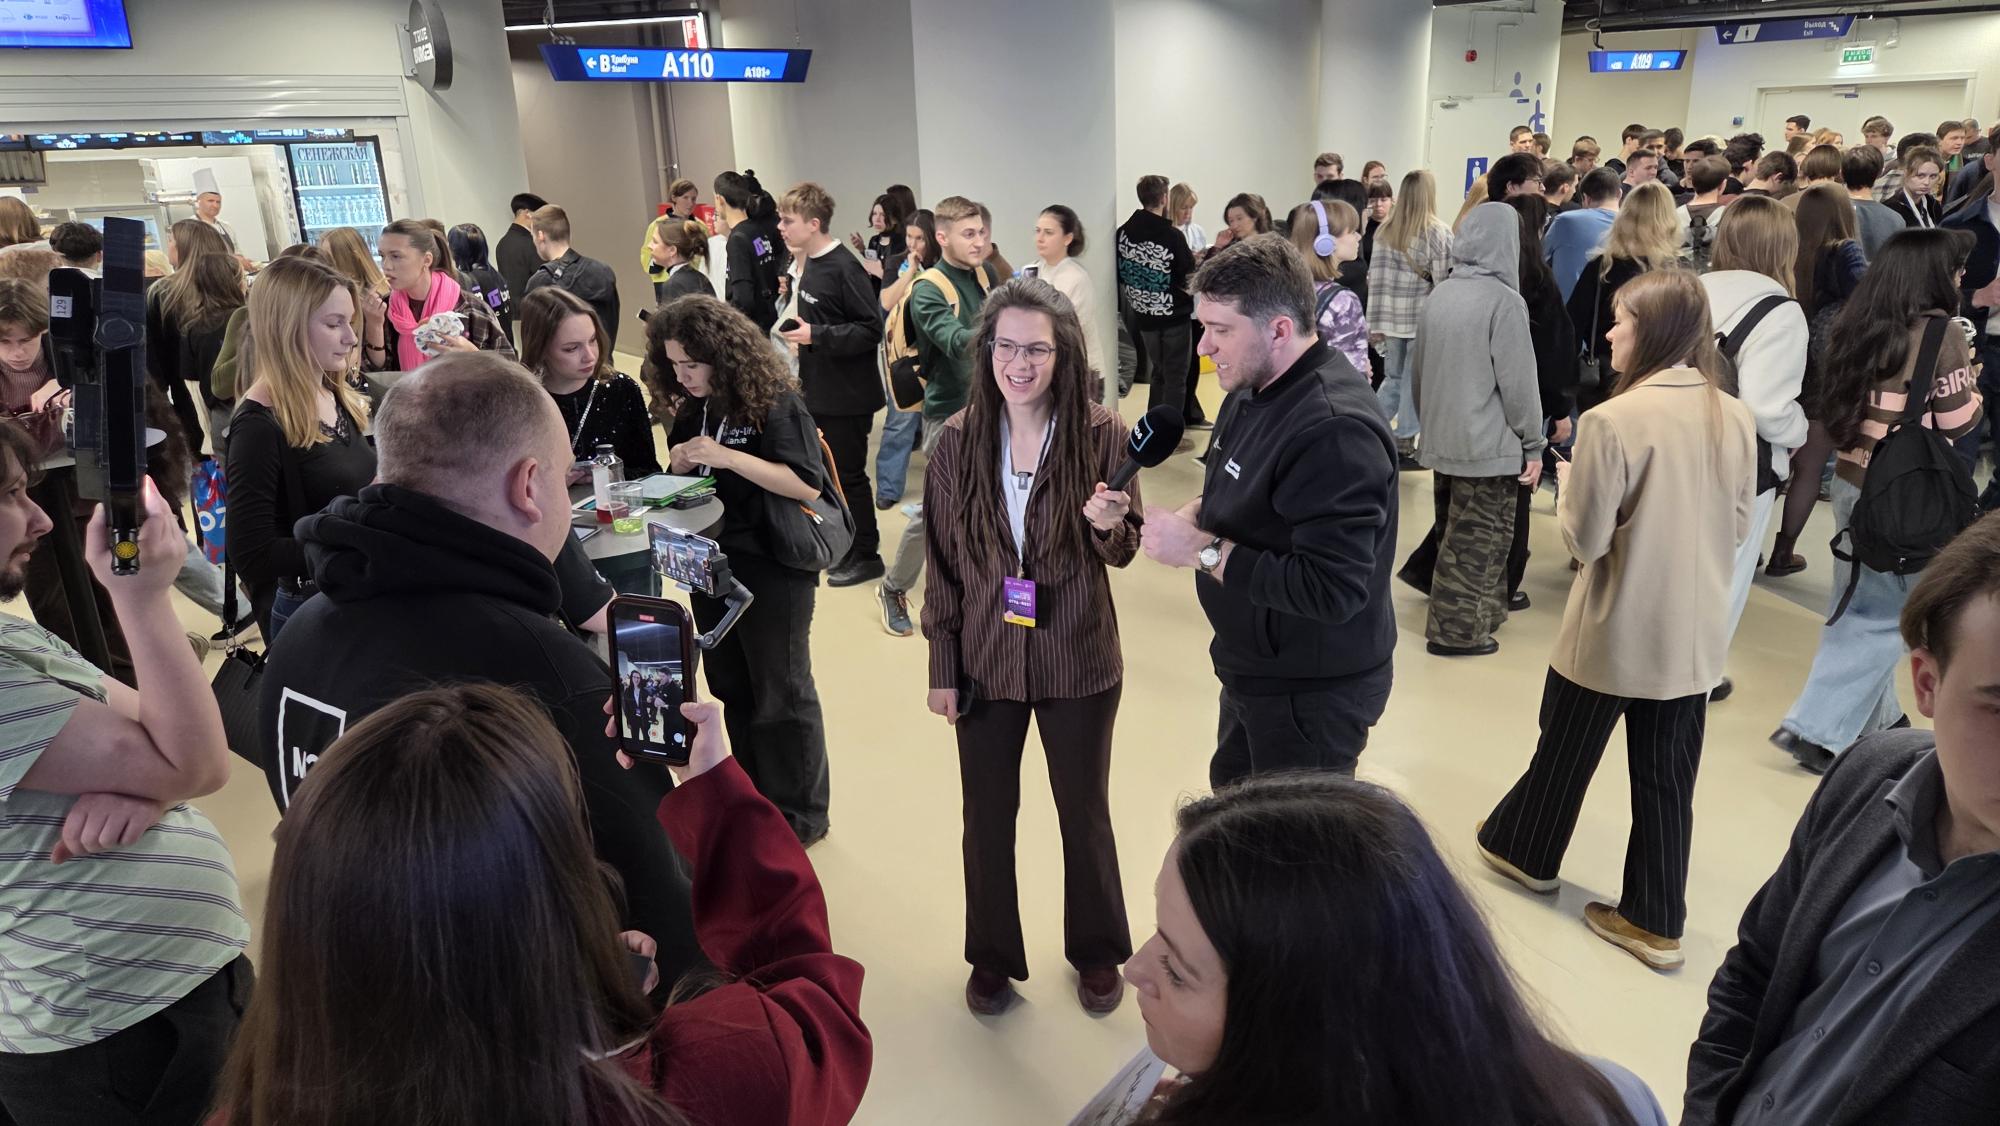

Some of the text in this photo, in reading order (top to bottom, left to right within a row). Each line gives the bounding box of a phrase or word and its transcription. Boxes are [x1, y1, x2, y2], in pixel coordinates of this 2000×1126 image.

[412, 26, 428, 44] TRUE
[662, 51, 714, 78] A110
[297, 146, 369, 162] СЕНЕЖСКАЯ
[56, 299, 67, 314] 129
